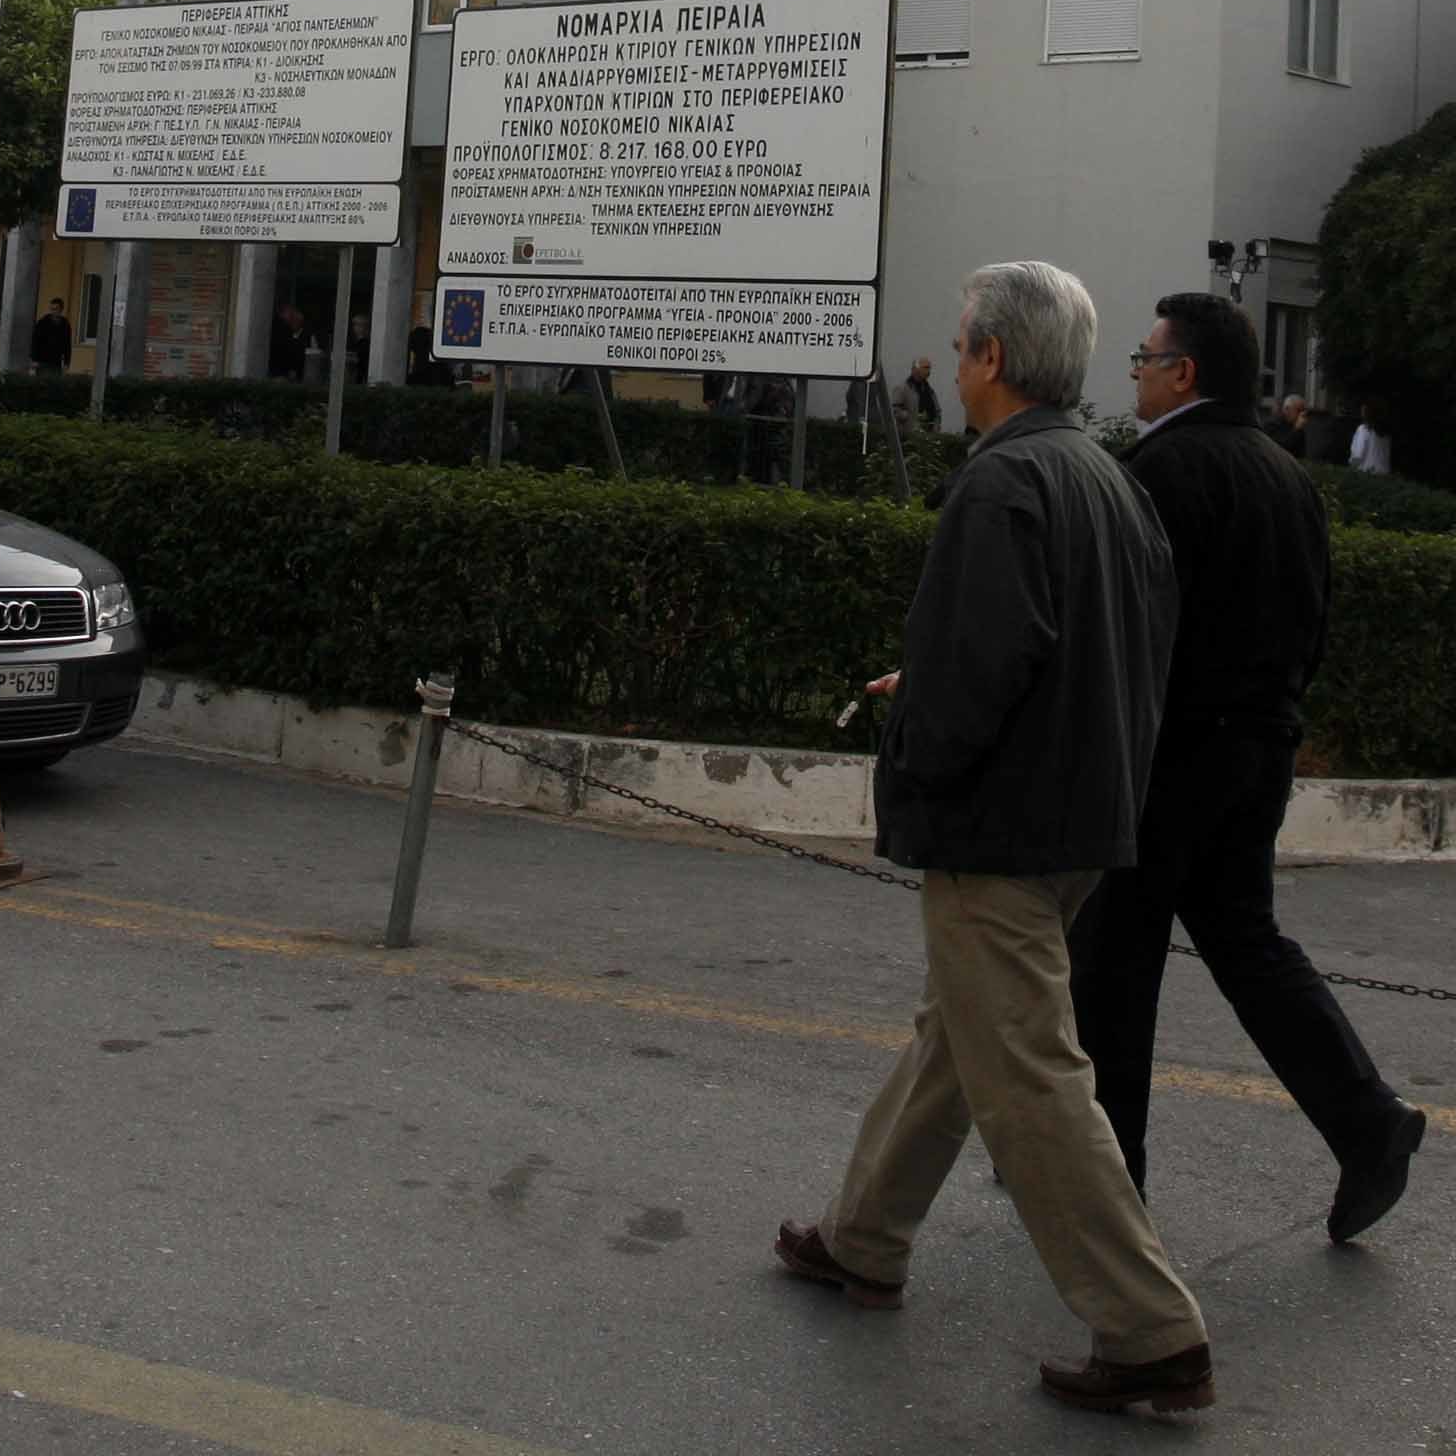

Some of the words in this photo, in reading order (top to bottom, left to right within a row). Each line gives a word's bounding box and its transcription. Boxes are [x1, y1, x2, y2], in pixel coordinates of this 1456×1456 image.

[182, 8, 242, 22] ΠΕΡΙΦΕΡΕΙΑ
[244, 4, 289, 19] ΑΤΤΙΚΗΣ
[556, 9, 664, 38] ΝΟΜΑΡΧΙΑ
[677, 3, 766, 31] ΠΕΙΡΑΙΑ
[133, 26, 190, 40] ΝΟΣΟΚΟΜΕΙΟ
[234, 22, 269, 35] ΠΕΙΡΑΙΑ
[290, 39, 309, 51] ΠΟΥ
[386, 34, 407, 47] ΑΠΟ
[460, 49, 501, 67] ΕΡΓΟ:
[506, 45, 608, 65] ΟΛΟΚΛΗΡΩΣΗ
[616, 40, 677, 60] ΚΤΙΡΙΟΥ
[685, 37, 756, 57] ΓΕΝΙΚΩΝ
[764, 32, 861, 53] ΥΠΗΡΕΣΙΩΝ
[504, 72, 529, 89] ΚΑΙ
[240, 102, 278, 114] ΑΤΤΙΚΗΣ
[504, 94, 604, 113] ΥΠΑΡΧΟΝΤΩΝ
[612, 91, 673, 111] ΚΤΙΡΙΩΝ
[682, 90, 713, 108] ΣΤΟ
[721, 85, 844, 107] ΠΕΡΙΦΕΡΕΙΑΚΟ
[265, 117, 302, 129] ΠΕΙΡΑΙΑ
[501, 119, 553, 137] ΓΕΝΙΚΟ
[560, 116, 659, 136] ΝΟΣΟΚΟΜΕΙΟ
[668, 114, 735, 133] ΝΙΚΑΙΑΣ
[321, 130, 393, 143] ΝΟΣΟΚΟΜΕΙΟΥ
[724, 140, 767, 158] ΕΥΡΩ
[452, 167, 496, 180] ΦΟΡΕΑΣ
[497, 166, 607, 180] ΧΡΗΜΑΤΟΔΟΤΗΣΗΣ:
[611, 165, 676, 180] ΥΠΟΥΡΓΕΙΟ
[681, 164, 722, 178] ΥΓΕΙΑΣ
[725, 165, 733, 178] &
[737, 163, 803, 177] ΠΡΟΝΟΙΑΣ
[531, 185, 564, 198] ΑΡΧΗ:
[605, 184, 664, 198] ΤΕΧΝΙΚΩΝ
[668, 184, 736, 197] ΥΠΗΡΕΣΙΩΝ
[741, 183, 814, 197] ΝΟΜΑΡΧΙΑΣ
[818, 183, 871, 197] ΠΕΙΡΑΙΑ
[449, 213, 524, 226] ΔΙΕΥΘΥΝΟΥΣΑ
[528, 213, 586, 226] ΥΠΗΡΕΣΙΑ:
[592, 203, 633, 217] ΤΜΗΜΑ
[637, 204, 706, 217] ΕΚΤΕΛΕΣΗΣ
[708, 204, 750, 217] ΕΡΓΩΝ
[753, 203, 834, 217] ΔΙΕΥΘΥΝΣΗΣ
[591, 222, 648, 236] ΤΕΧΝΙΚΩΝ
[652, 222, 721, 236] ΥΠΗΡΕΣΙΩΝ
[447, 251, 509, 264] ΑΝΑΔΟΧΟΣ:
[497, 285, 512, 297] ΤΟ
[515, 285, 544, 298] ΕΡΓΟ
[546, 286, 676, 302] ΣΥΓΧΡΗΜΑΤΟΔΟΤΕΙΤΑΙ
[680, 289, 706, 302] ΑΠΟ
[710, 289, 735, 303] ΤΗΝ
[816, 292, 860, 307] ΕΝΩΣΗ
[499, 304, 584, 318] ΕΠΙΧΕΙΡΗΣΙΑΚΟ
[587, 306, 662, 321] ΠΡΟΓΡΑΜΜΑ
[783, 312, 812, 326] 2000
[823, 313, 853, 327] 2006
[609, 326, 653, 340] ΤΑΜΕΙΟ
[656, 328, 755, 344] ΠΕΡΙΦΕΡΕΙΑΚΗΣ
[758, 331, 834, 346] ΑΝΑΠΤΥΞΗΣ
[607, 345, 657, 359] ΕΘΝΙΚΟΙ
[660, 347, 698, 362] ΠΟΡΟΙ
[701, 350, 726, 364] 25%
